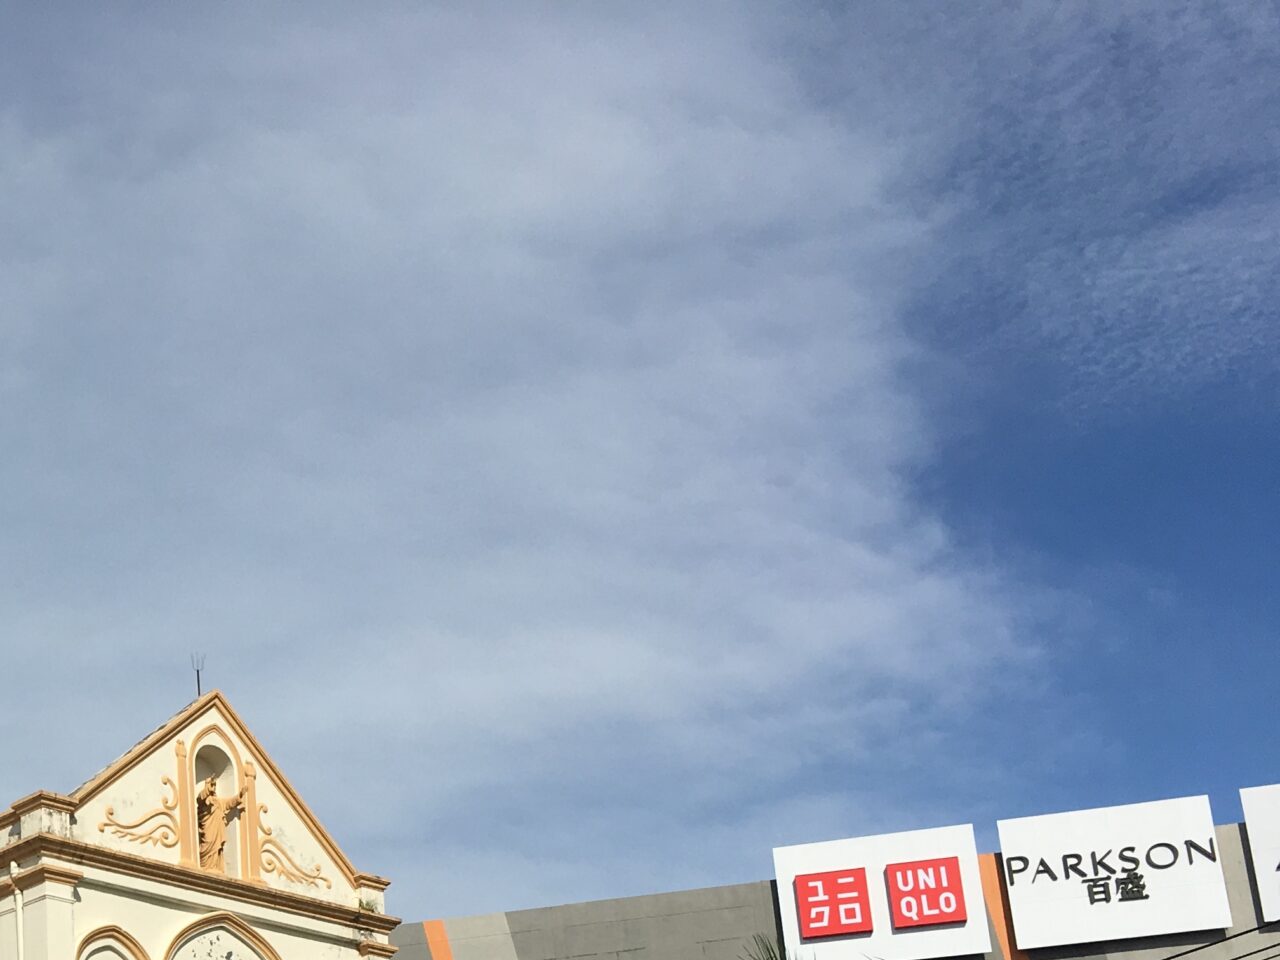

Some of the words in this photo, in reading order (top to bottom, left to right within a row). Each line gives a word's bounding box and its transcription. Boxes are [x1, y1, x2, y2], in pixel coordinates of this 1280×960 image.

[1005, 837, 1217, 886] PARKSON
[896, 866, 948, 892] UNI
[1081, 872, 1150, 905] 百盛
[900, 892, 957, 921] QLO
